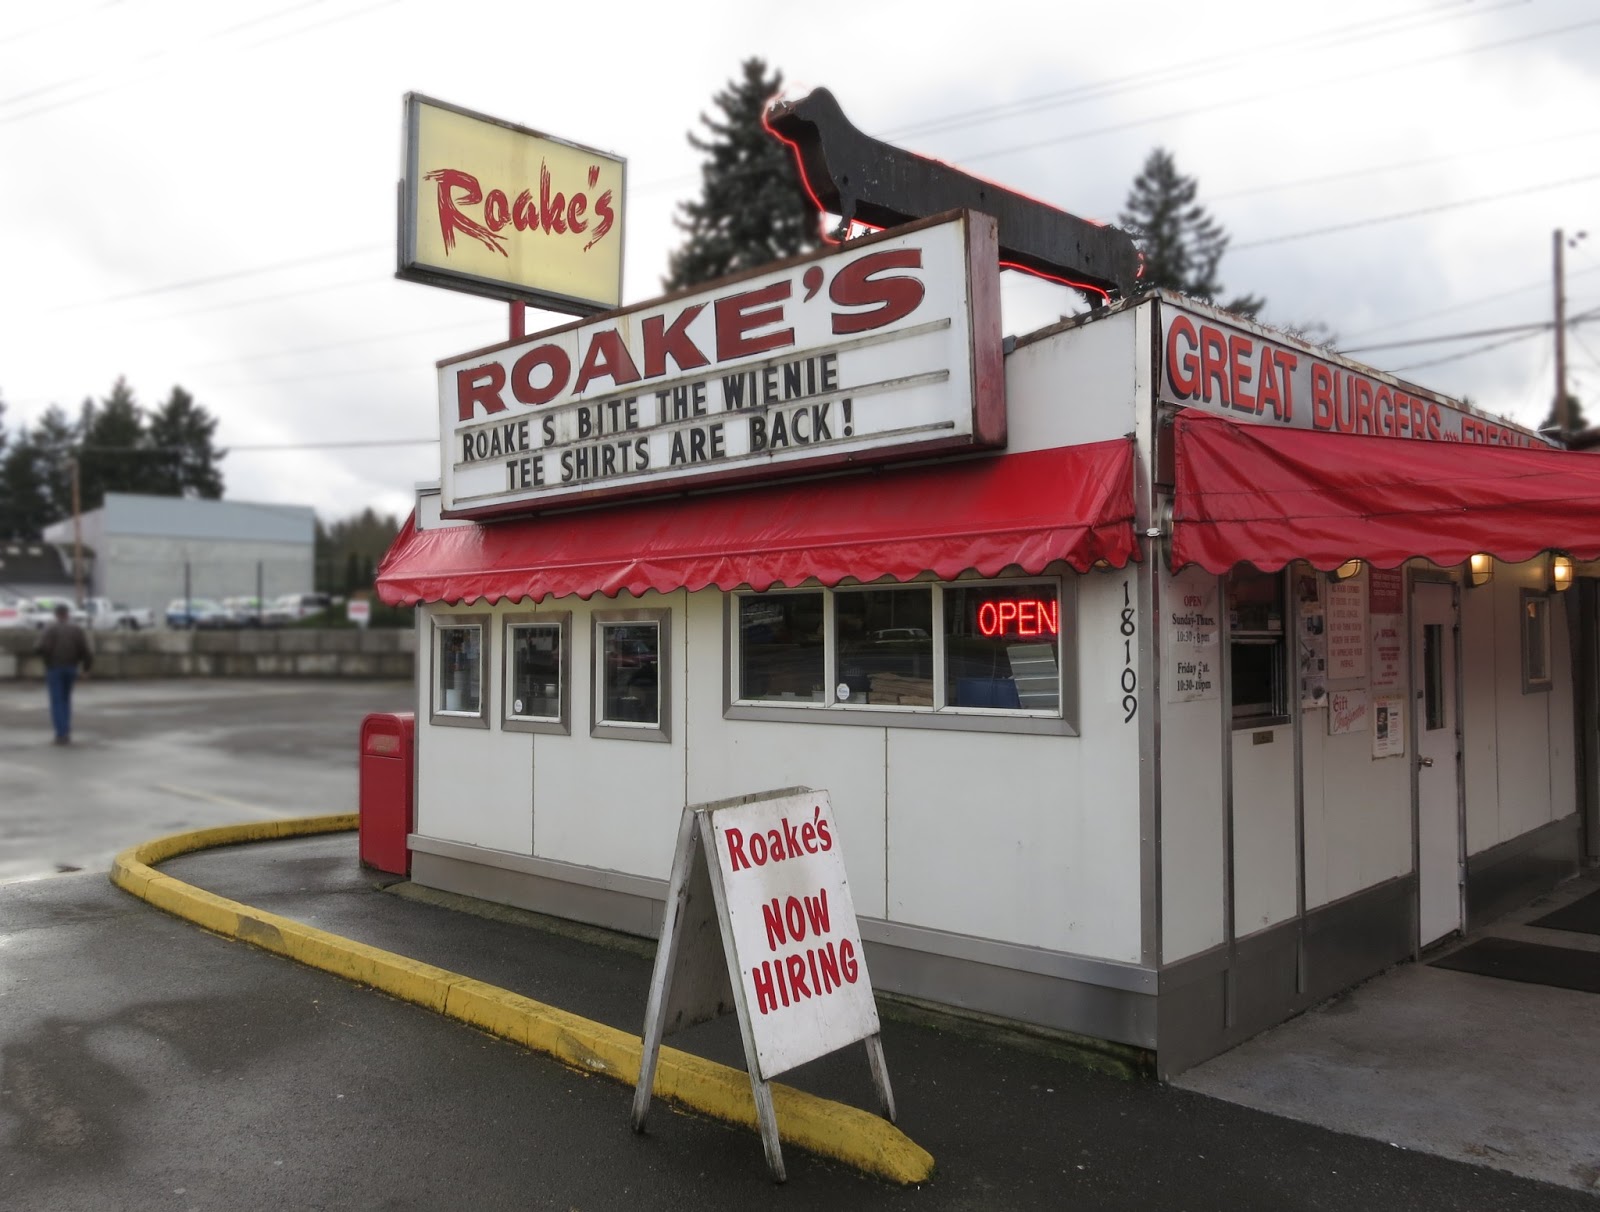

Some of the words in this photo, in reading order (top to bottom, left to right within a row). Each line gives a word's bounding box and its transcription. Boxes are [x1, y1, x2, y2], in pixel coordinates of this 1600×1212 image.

[423, 156, 614, 258] Roake's
[457, 248, 926, 422] ROAKE'S
[463, 421, 530, 461] ROAKE
[578, 397, 638, 438] BITE
[656, 382, 707, 423] THE
[722, 353, 838, 411] WIENIE
[1167, 314, 1297, 423] GREAT
[1311, 362, 1441, 441] BURGERS
[506, 456, 545, 490] TEE
[561, 437, 650, 482] SHIRTS
[670, 424, 725, 466] ARE
[978, 599, 1058, 636] OPEN
[1183, 595, 1202, 607] OPEN
[1120, 580, 1138, 724] 18109
[724, 806, 833, 872] Roake's
[762, 888, 830, 951] NOW
[752, 938, 858, 1015] HIRING
